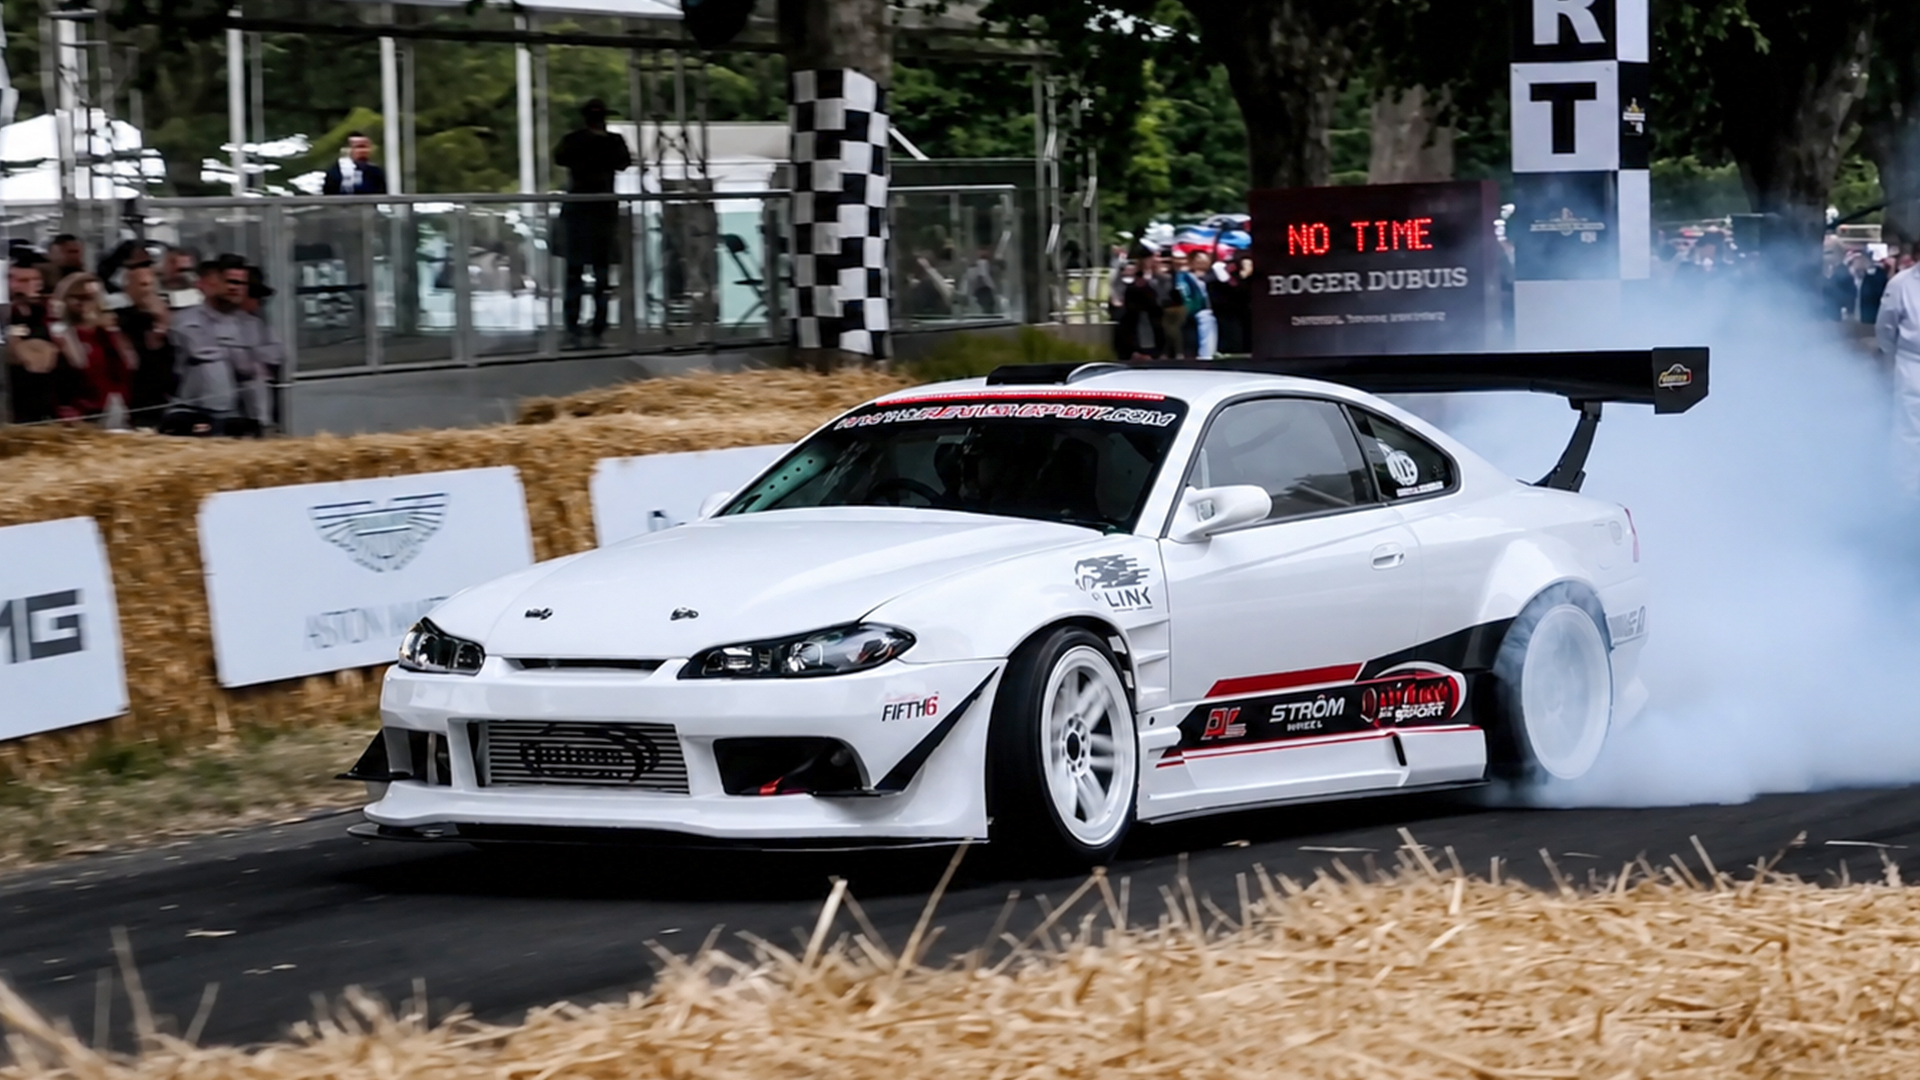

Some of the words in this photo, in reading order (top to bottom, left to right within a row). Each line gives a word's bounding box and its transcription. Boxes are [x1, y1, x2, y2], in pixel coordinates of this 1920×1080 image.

[1288, 222, 1330, 255] NO
[1351, 217, 1433, 252] TIME
[1367, 267, 1468, 291] DUBUIS
[1104, 586, 1152, 607] LINK
[882, 696, 938, 721] FIFTH6
